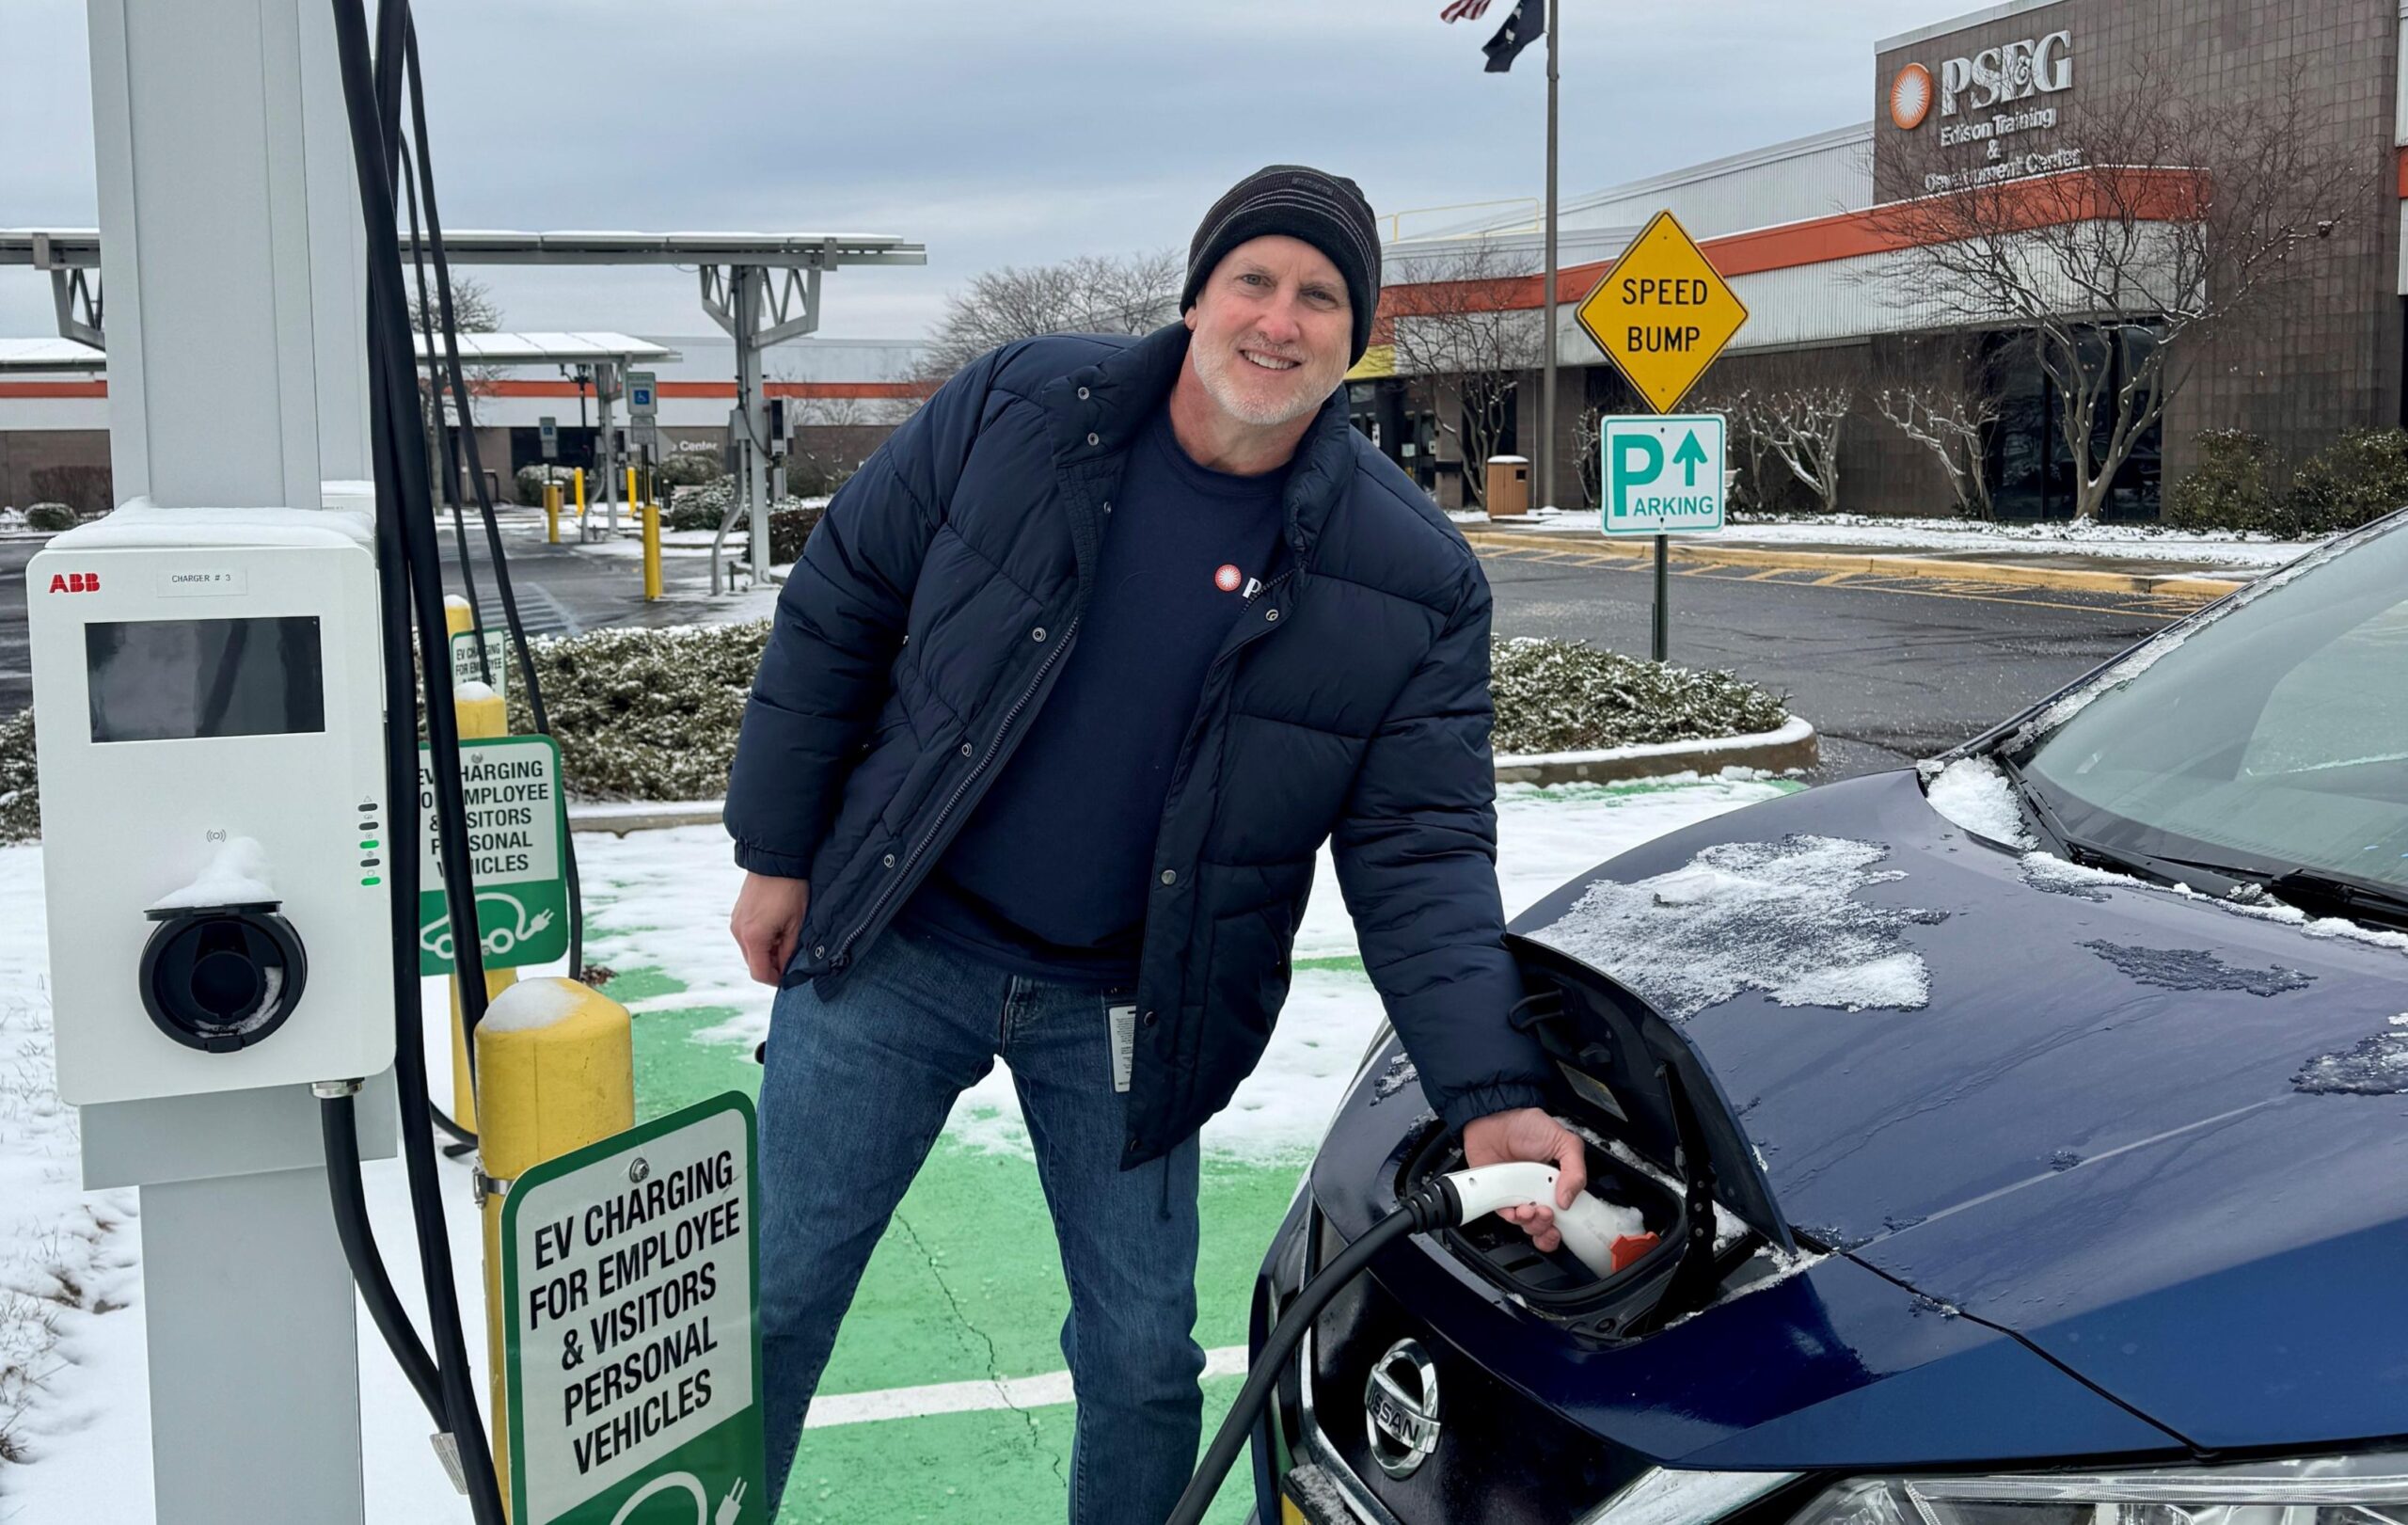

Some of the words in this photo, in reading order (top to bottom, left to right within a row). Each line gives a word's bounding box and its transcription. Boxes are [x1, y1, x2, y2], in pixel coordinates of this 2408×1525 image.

[1941, 122, 1993, 147] Edison
[1992, 106, 2057, 136] Training
[1987, 138, 2001, 160] &
[1623, 278, 1707, 305] SPEED
[1628, 326, 1700, 352] BUMP
[679, 439, 718, 452] Center
[49, 572, 101, 594] ABB
[171, 574, 210, 583] CHARGER
[460, 760, 544, 783] HARGING
[464, 783, 549, 806] MPLOYEE
[467, 807, 532, 829] SITORS
[431, 831, 533, 855] PSONAL
[535, 1216, 574, 1271] EV
[584, 1150, 733, 1247] CHARGING
[530, 1268, 588, 1330] FOR
[598, 1198, 740, 1297] EMPLOYEE
[561, 1328, 584, 1371] &
[591, 1262, 717, 1355] VISITORS
[564, 1316, 718, 1427] PERSONAL
[573, 1369, 712, 1476] VEHICLES
